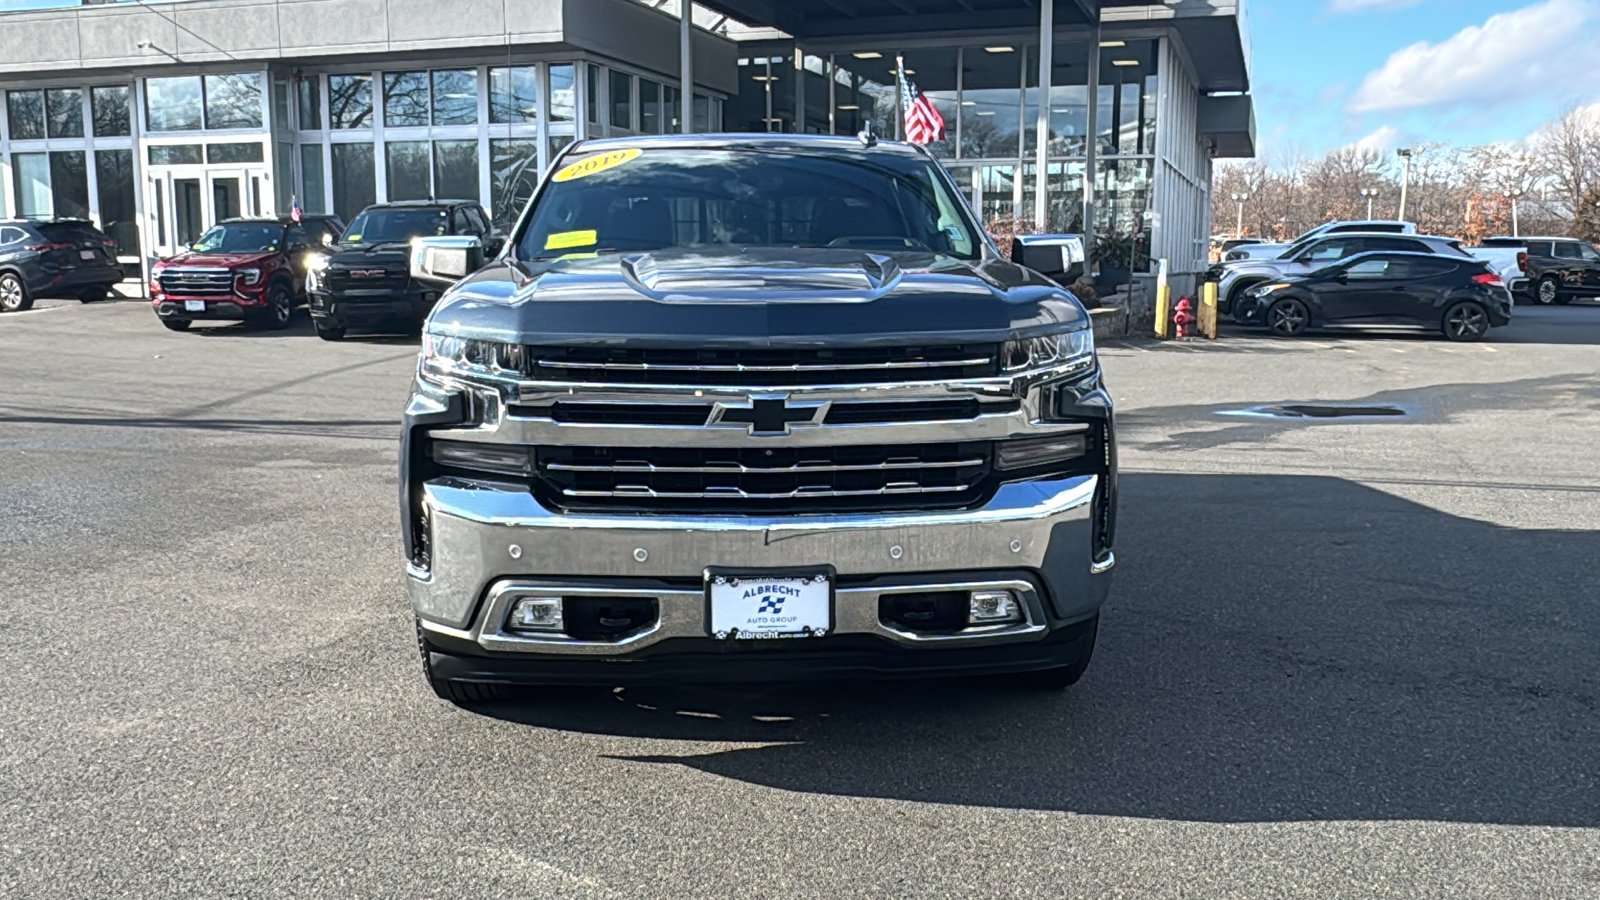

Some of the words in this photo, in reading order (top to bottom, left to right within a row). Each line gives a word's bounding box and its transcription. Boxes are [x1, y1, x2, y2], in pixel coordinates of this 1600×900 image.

[570, 152, 626, 177] 2019
[350, 269, 385, 278] GMC
[742, 585, 801, 599] ALBRECHT
[770, 616, 797, 624] GROUP
[735, 630, 778, 639] Albrecht
